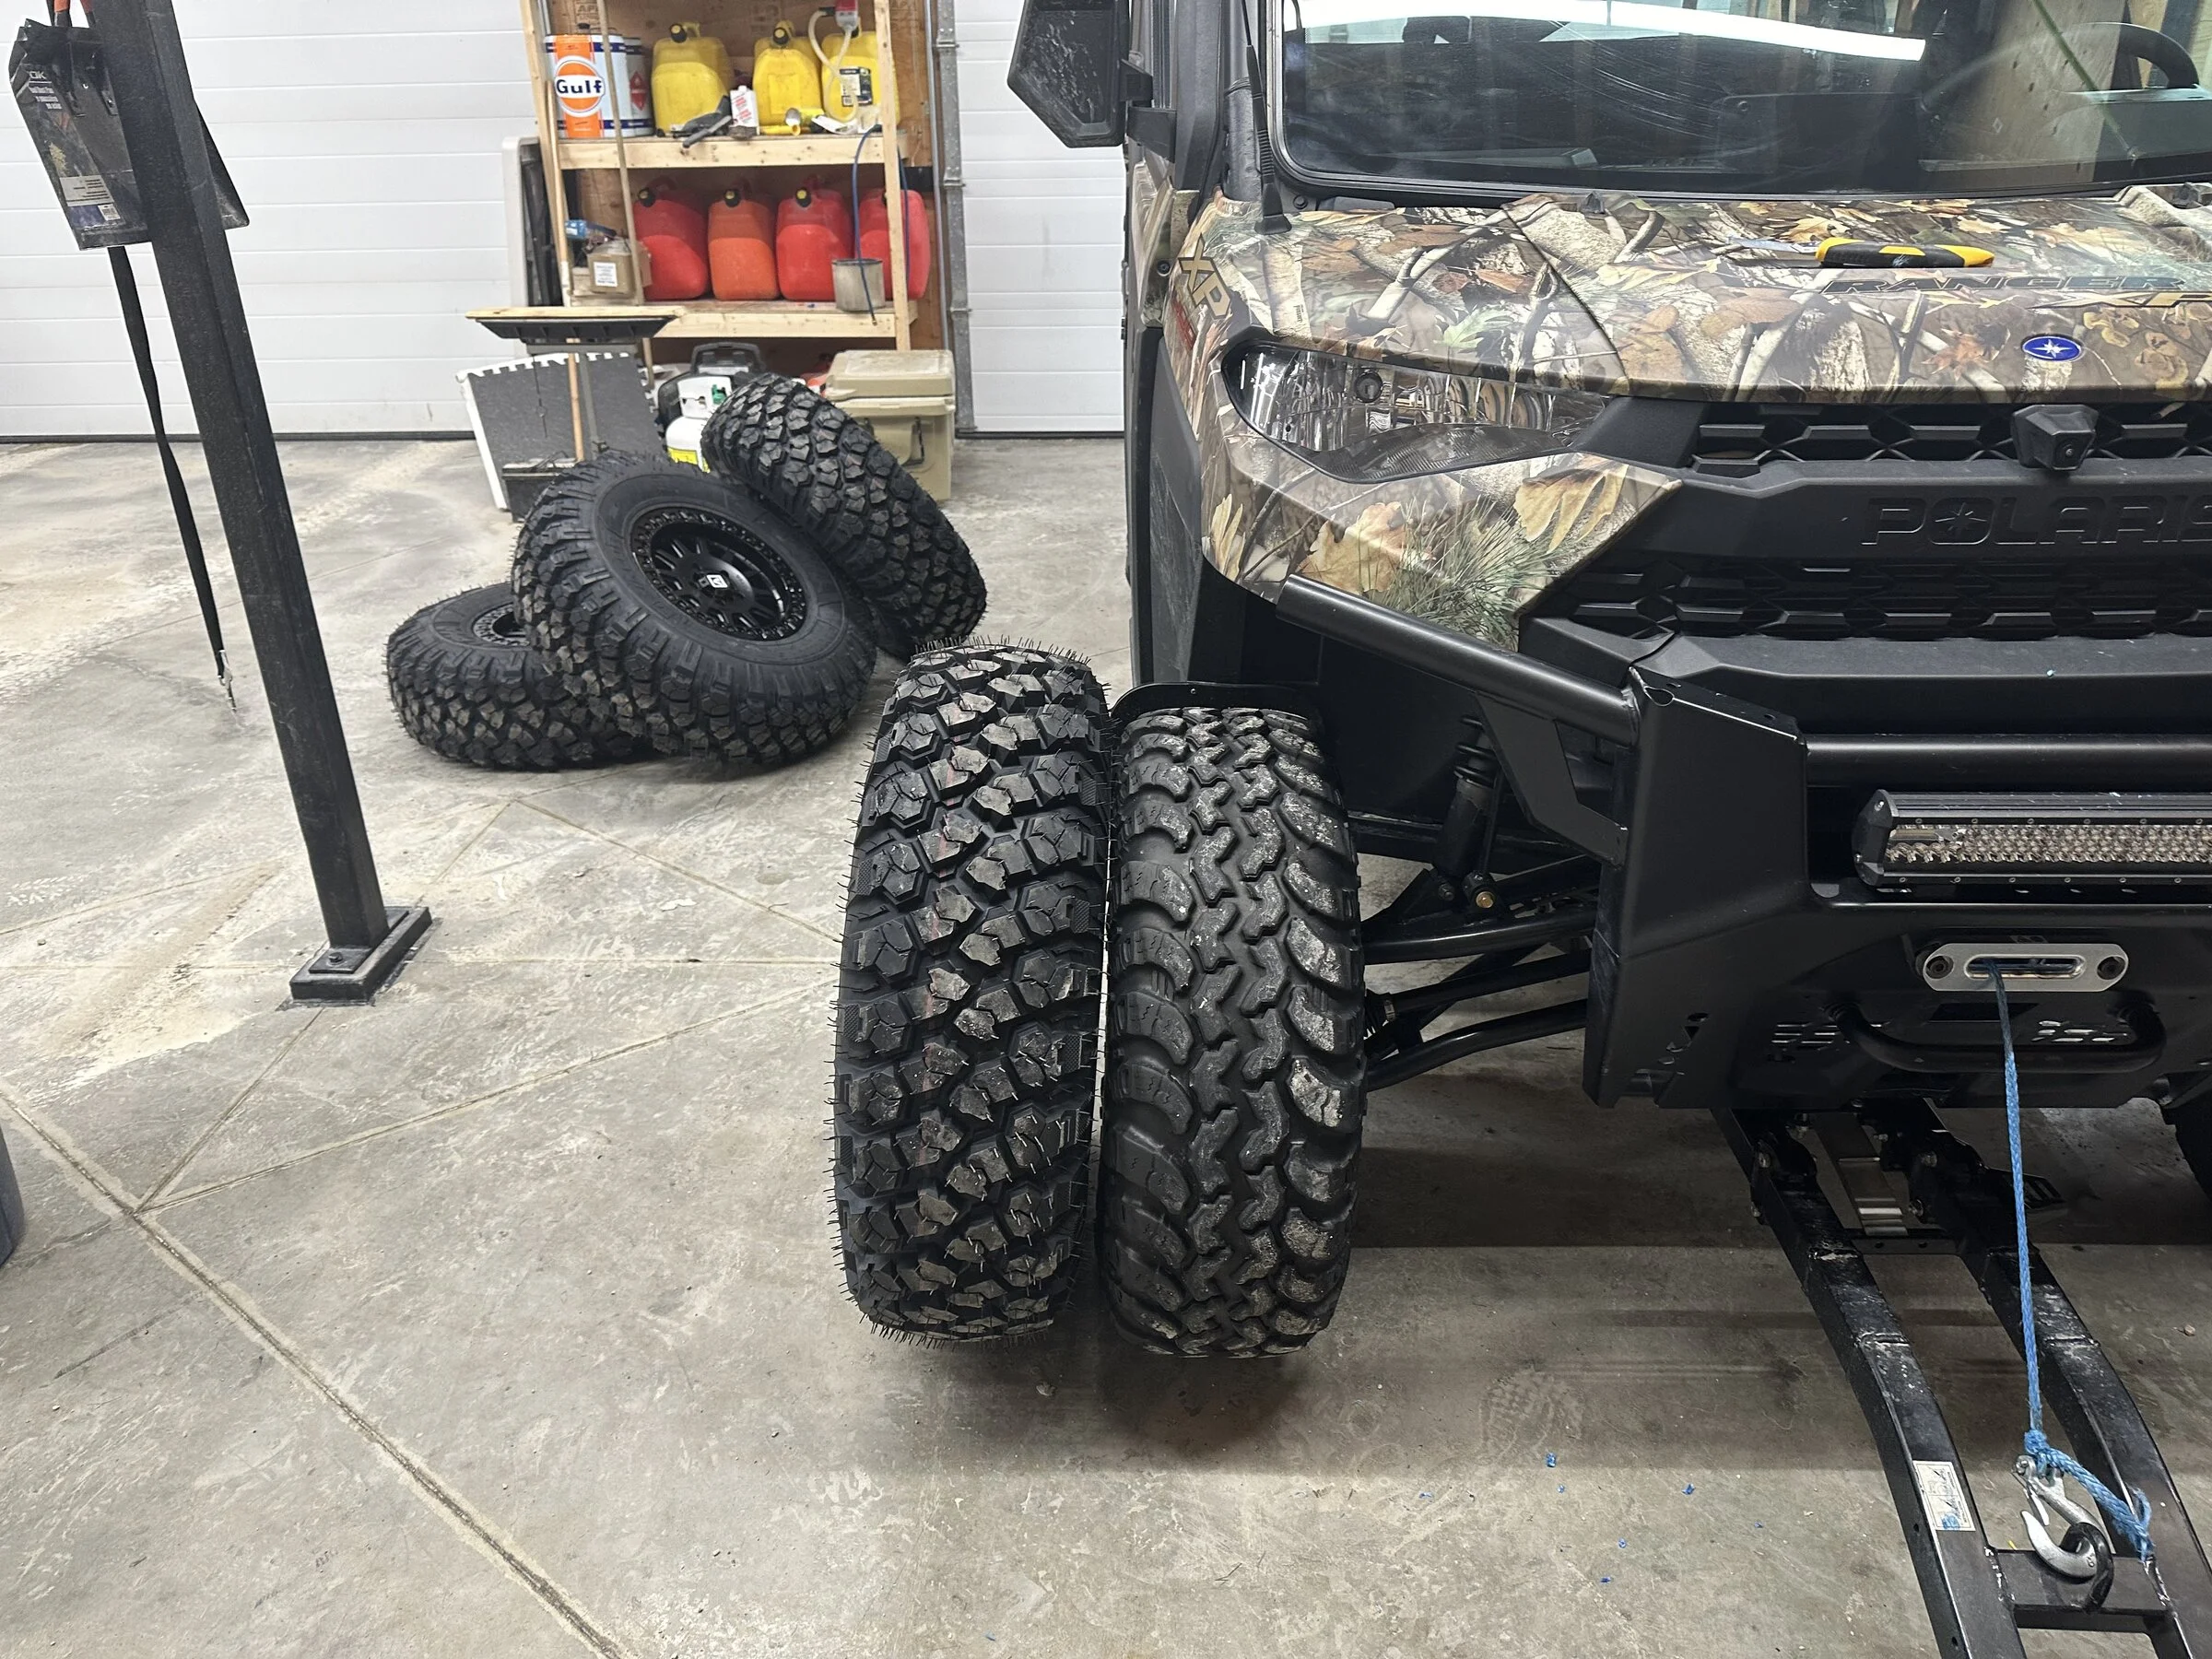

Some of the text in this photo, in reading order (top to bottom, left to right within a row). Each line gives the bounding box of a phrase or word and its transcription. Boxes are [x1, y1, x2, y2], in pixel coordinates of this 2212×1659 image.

[556, 79, 602, 93] Gulf
[1178, 233, 1231, 319] XP
[1819, 276, 2185, 294] RANGER
